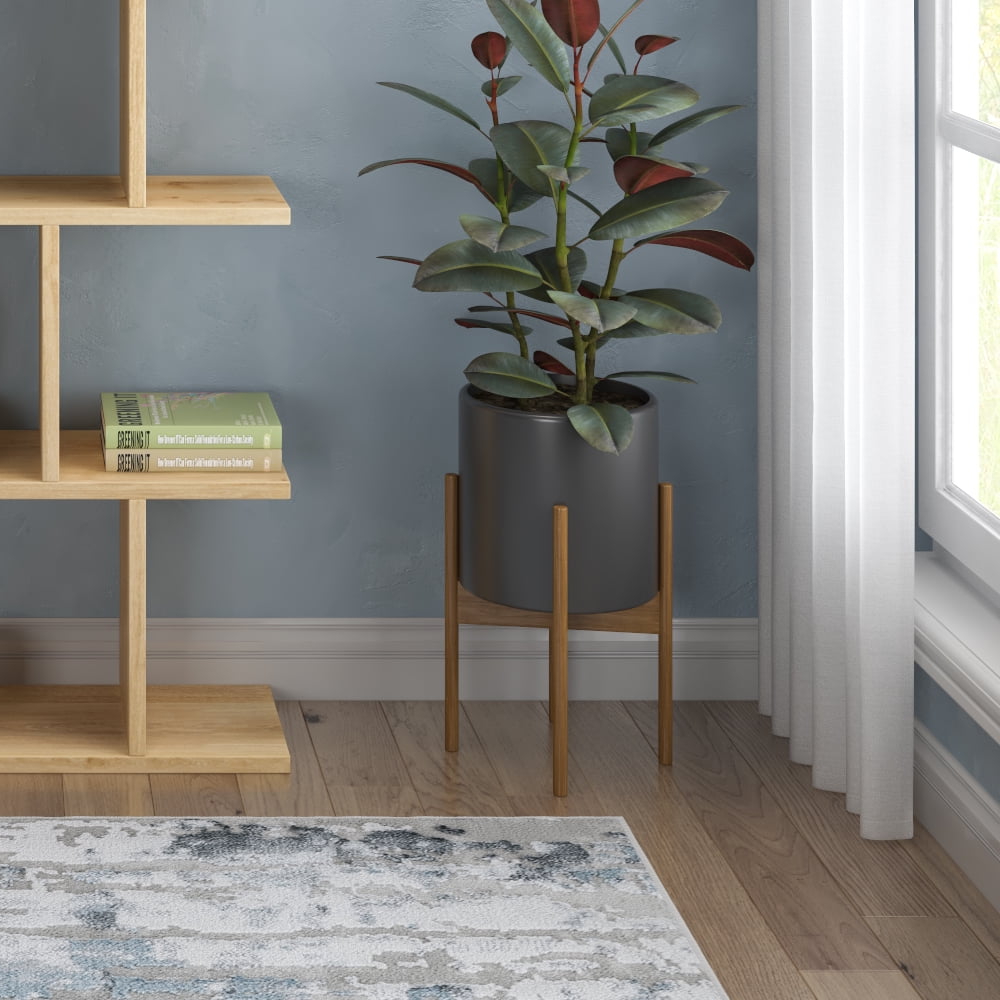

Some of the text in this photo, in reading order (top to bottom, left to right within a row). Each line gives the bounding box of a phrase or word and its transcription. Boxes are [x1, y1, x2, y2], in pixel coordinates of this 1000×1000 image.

[114, 399, 143, 426] GREENING
[116, 430, 144, 449] GREENING
[144, 430, 151, 449] IT
[116, 453, 144, 472] GREENING
[144, 453, 151, 472] IT
